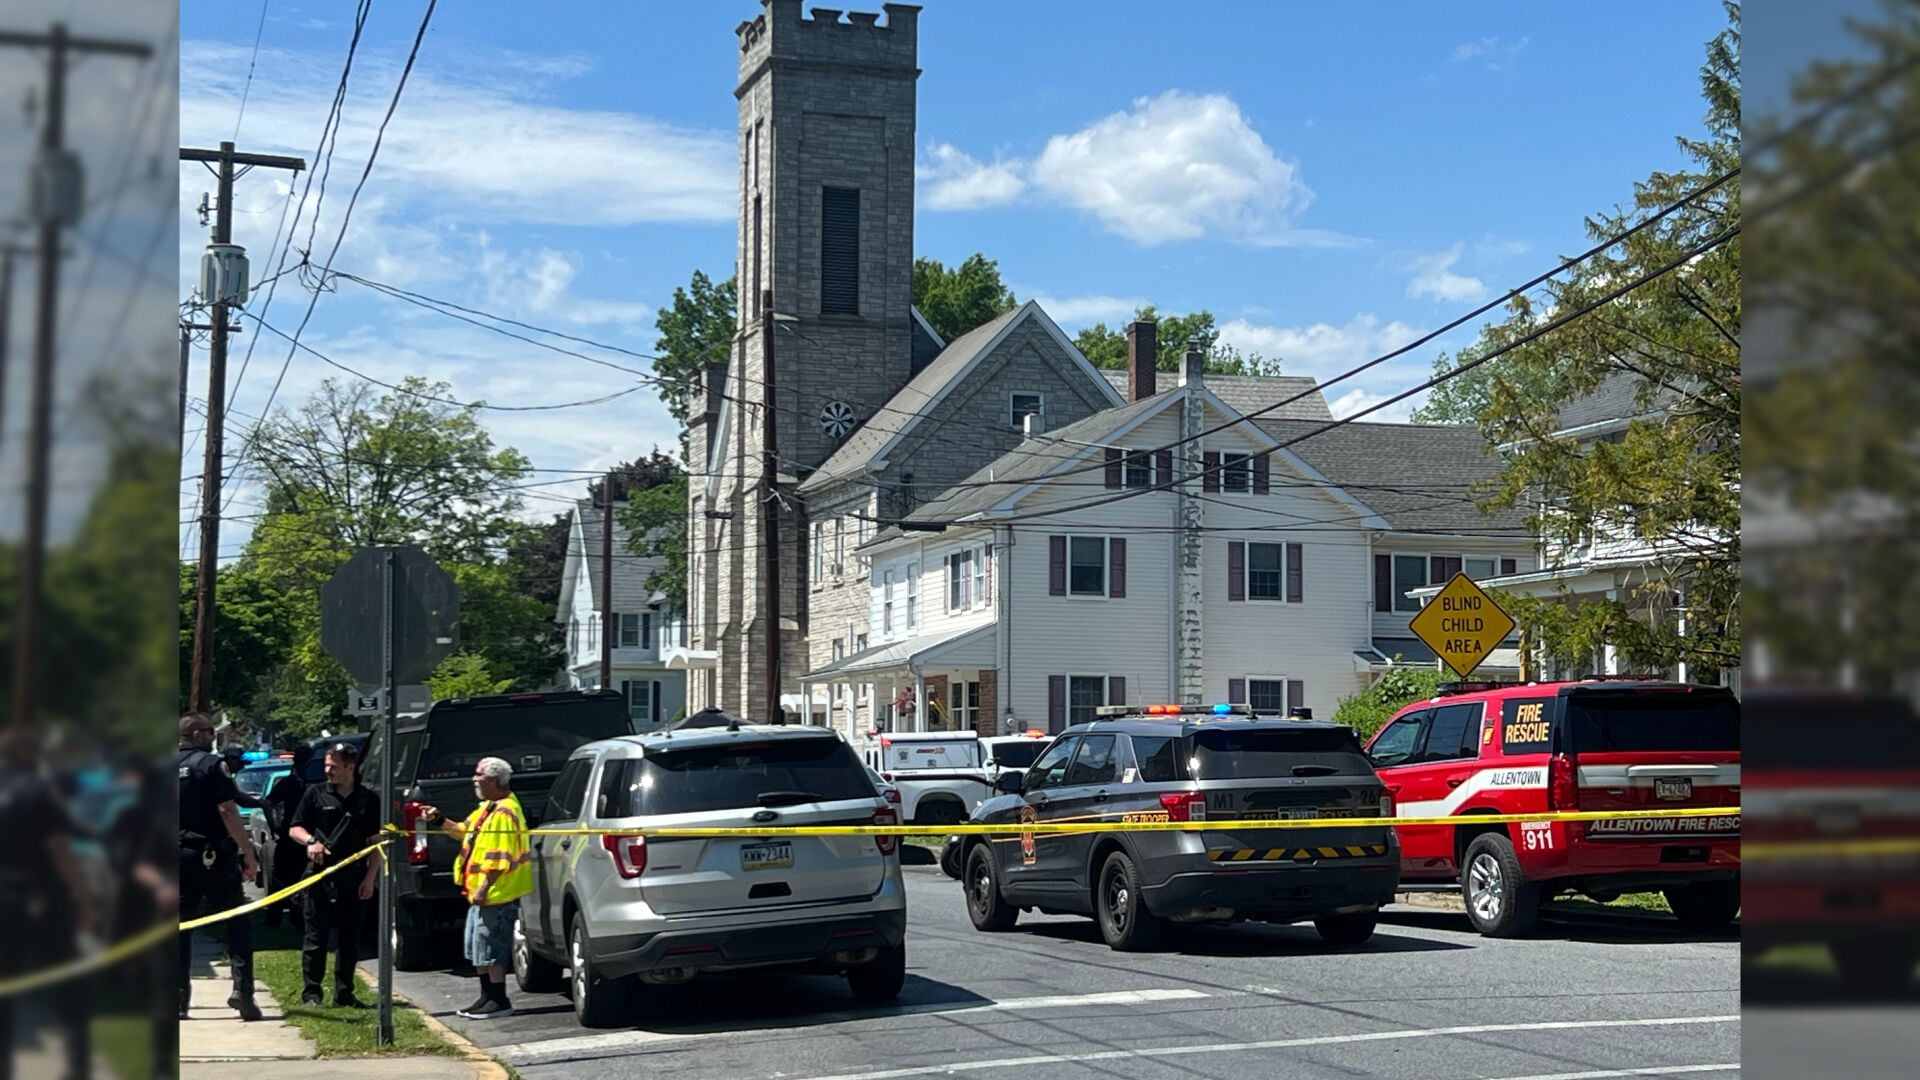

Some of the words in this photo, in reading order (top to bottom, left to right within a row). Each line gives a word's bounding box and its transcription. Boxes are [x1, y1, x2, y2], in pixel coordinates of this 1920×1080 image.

[1443, 596, 1481, 611] BLIND
[1441, 618, 1483, 632] CHILD
[1445, 640, 1482, 653] AREA
[1516, 704, 1543, 723] FIRE
[1505, 722, 1550, 743] RESCUE
[1490, 771, 1541, 786] ALLENTOWN
[1213, 793, 1234, 809] M1
[1360, 789, 1376, 804] 26
[1590, 819, 1675, 831] ALLENTOWN
[1677, 818, 1707, 830] FIRE
[1708, 817, 1740, 830] RESC
[1526, 829, 1553, 850] 911
